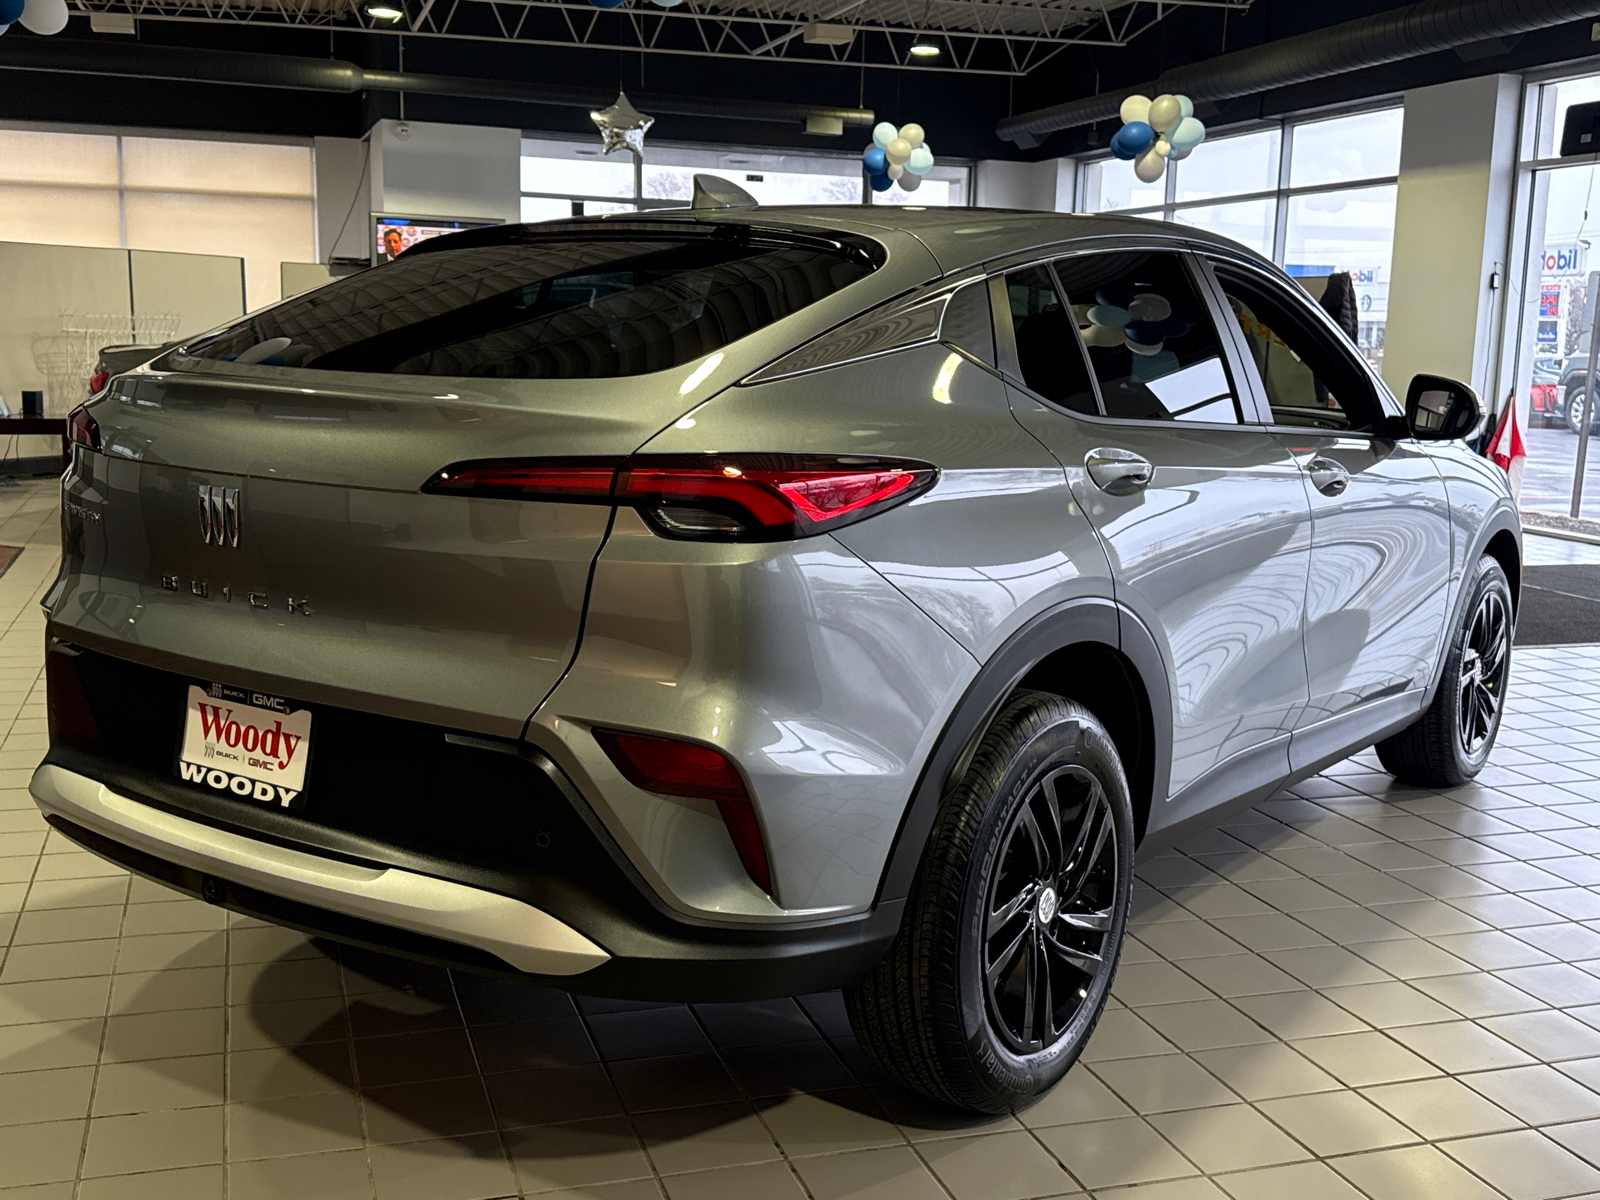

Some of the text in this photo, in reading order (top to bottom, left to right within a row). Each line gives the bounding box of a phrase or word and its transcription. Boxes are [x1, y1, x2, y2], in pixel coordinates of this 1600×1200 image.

[1351, 269, 1374, 283] obil
[161, 575, 311, 616] BUICK
[223, 688, 285, 710] BUICK GMC
[198, 702, 302, 770] Woody
[216, 750, 275, 771] BUICK GMC
[179, 760, 298, 808] WOODY
